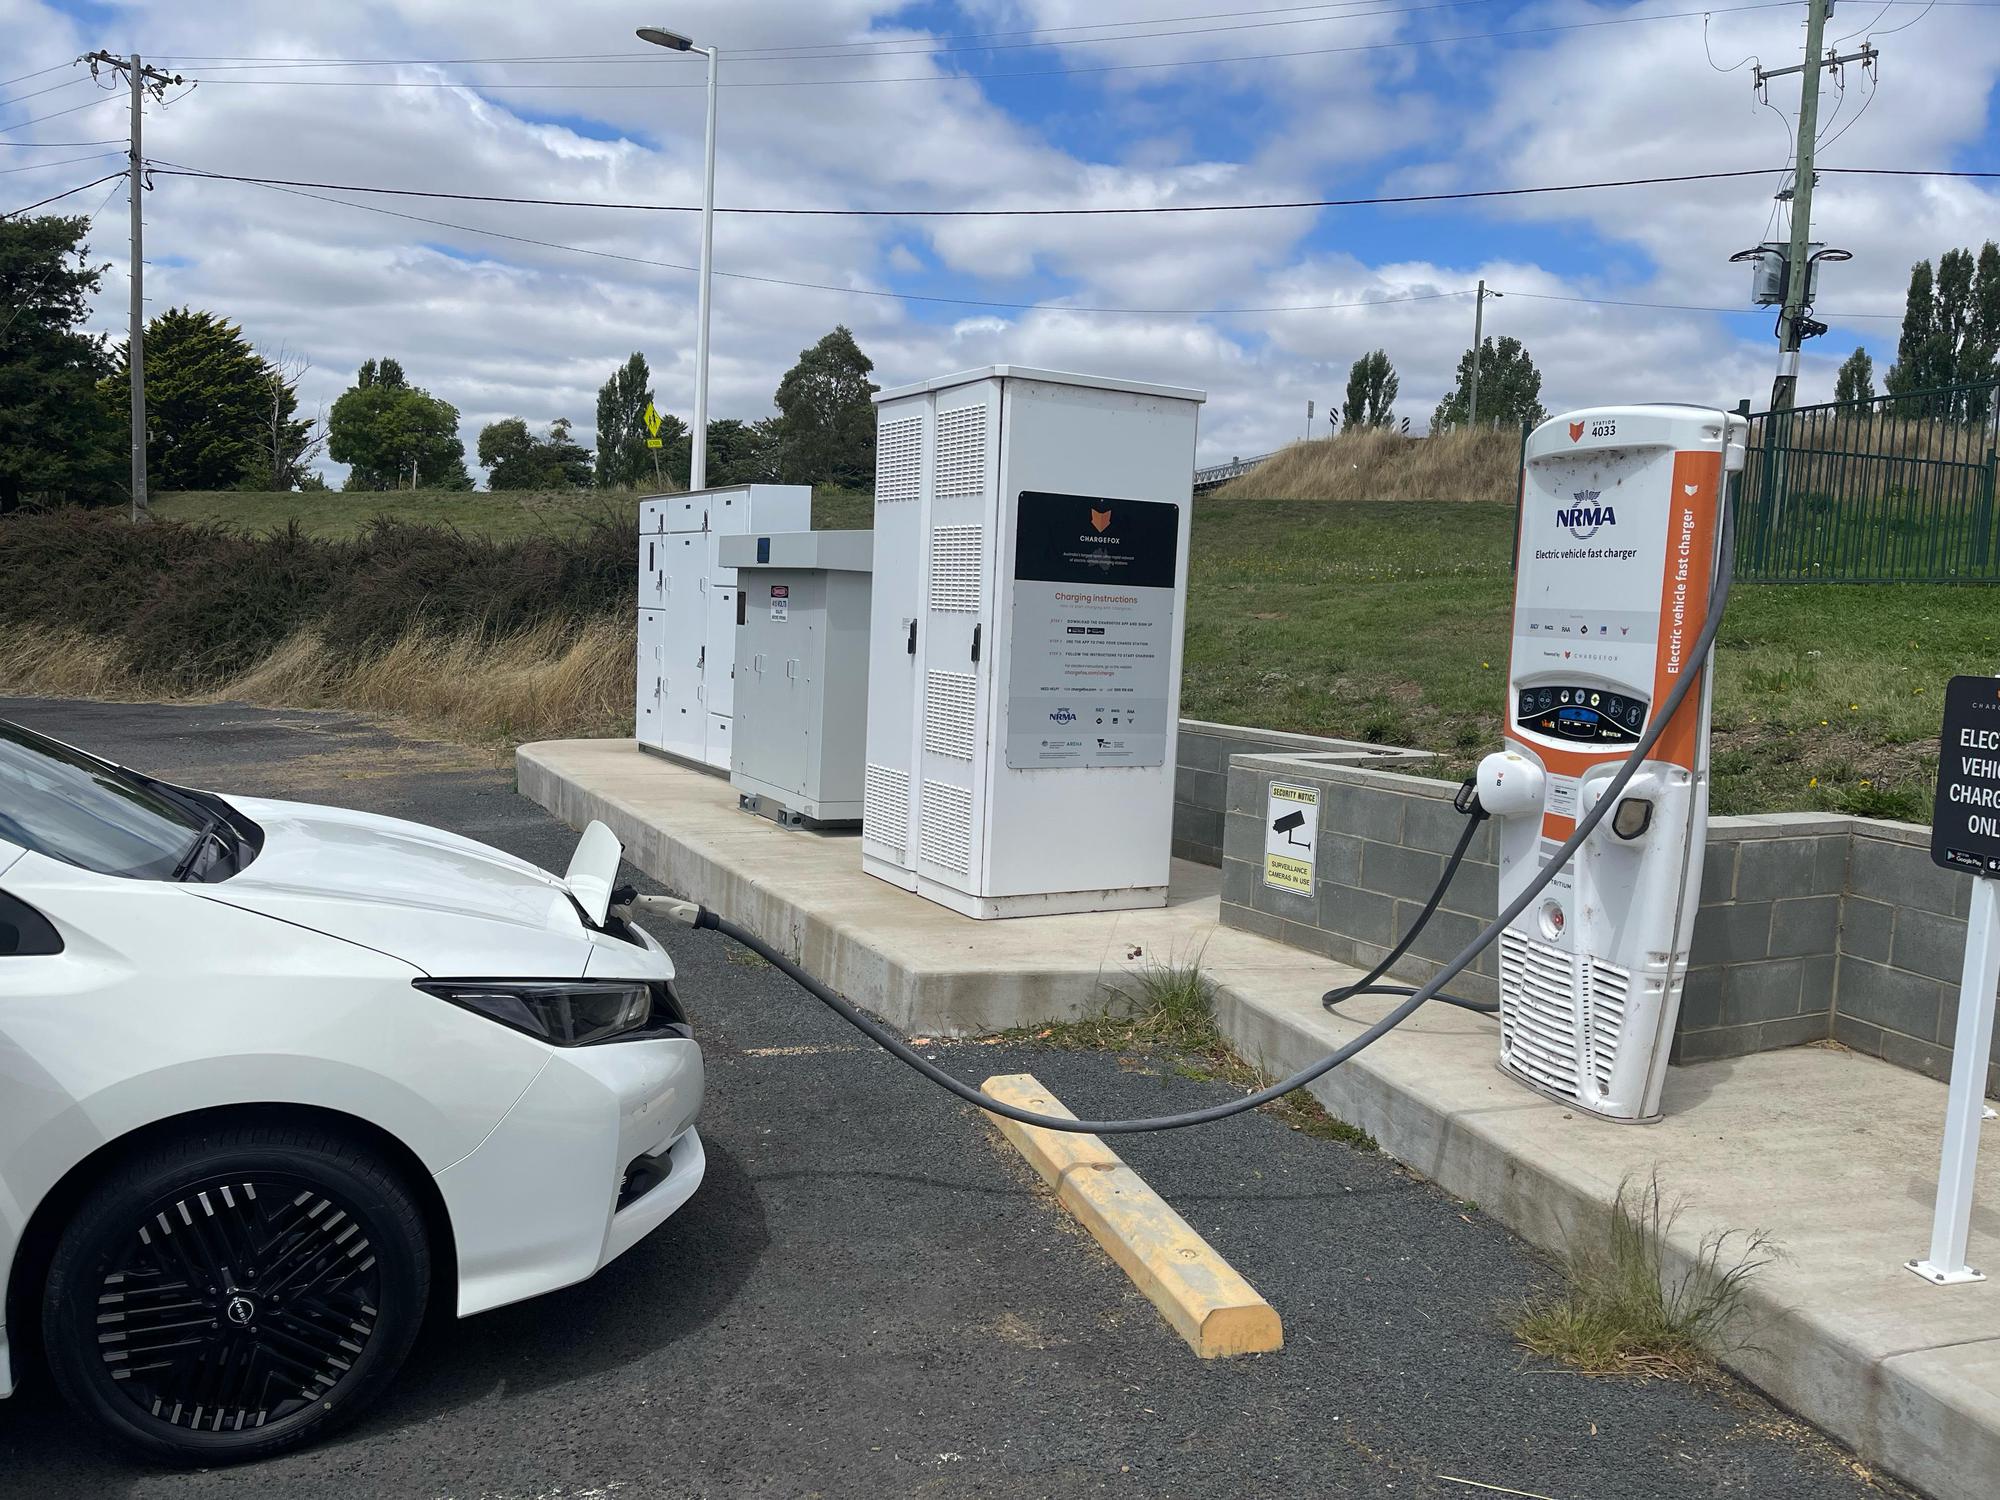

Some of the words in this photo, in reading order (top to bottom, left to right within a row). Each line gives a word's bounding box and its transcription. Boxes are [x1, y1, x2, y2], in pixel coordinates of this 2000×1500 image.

[1591, 425, 1616, 437] 4033
[1556, 506, 1616, 528] NRMA
[1079, 535, 1120, 544] CHARGEFOX
[1678, 508, 1695, 556] charger
[1535, 549, 1560, 559] Electric
[1560, 548, 1587, 559] vehicle
[1587, 547, 1603, 558] fast
[1603, 547, 1637, 561] charger
[1675, 558, 1689, 581] fast
[1054, 592, 1092, 604] Charging
[1093, 593, 1138, 604] instructions
[1672, 583, 1686, 627] vehicle
[1667, 629, 1682, 674] Electric
[1049, 713, 1077, 721] NRMA
[1960, 728, 2000, 750] ELEC
[1273, 787, 1297, 799] SECURITY
[1297, 791, 1316, 803] NOTICE
[1968, 814, 2000, 838] ONL
[1271, 860, 1308, 875] SURVEILLANCE
[1956, 855, 1973, 865] Google
[1972, 859, 1982, 867] Play
[1268, 870, 1292, 882] CAMERAS
[1292, 875, 1299, 883] IN
[1299, 877, 1310, 886] USE
